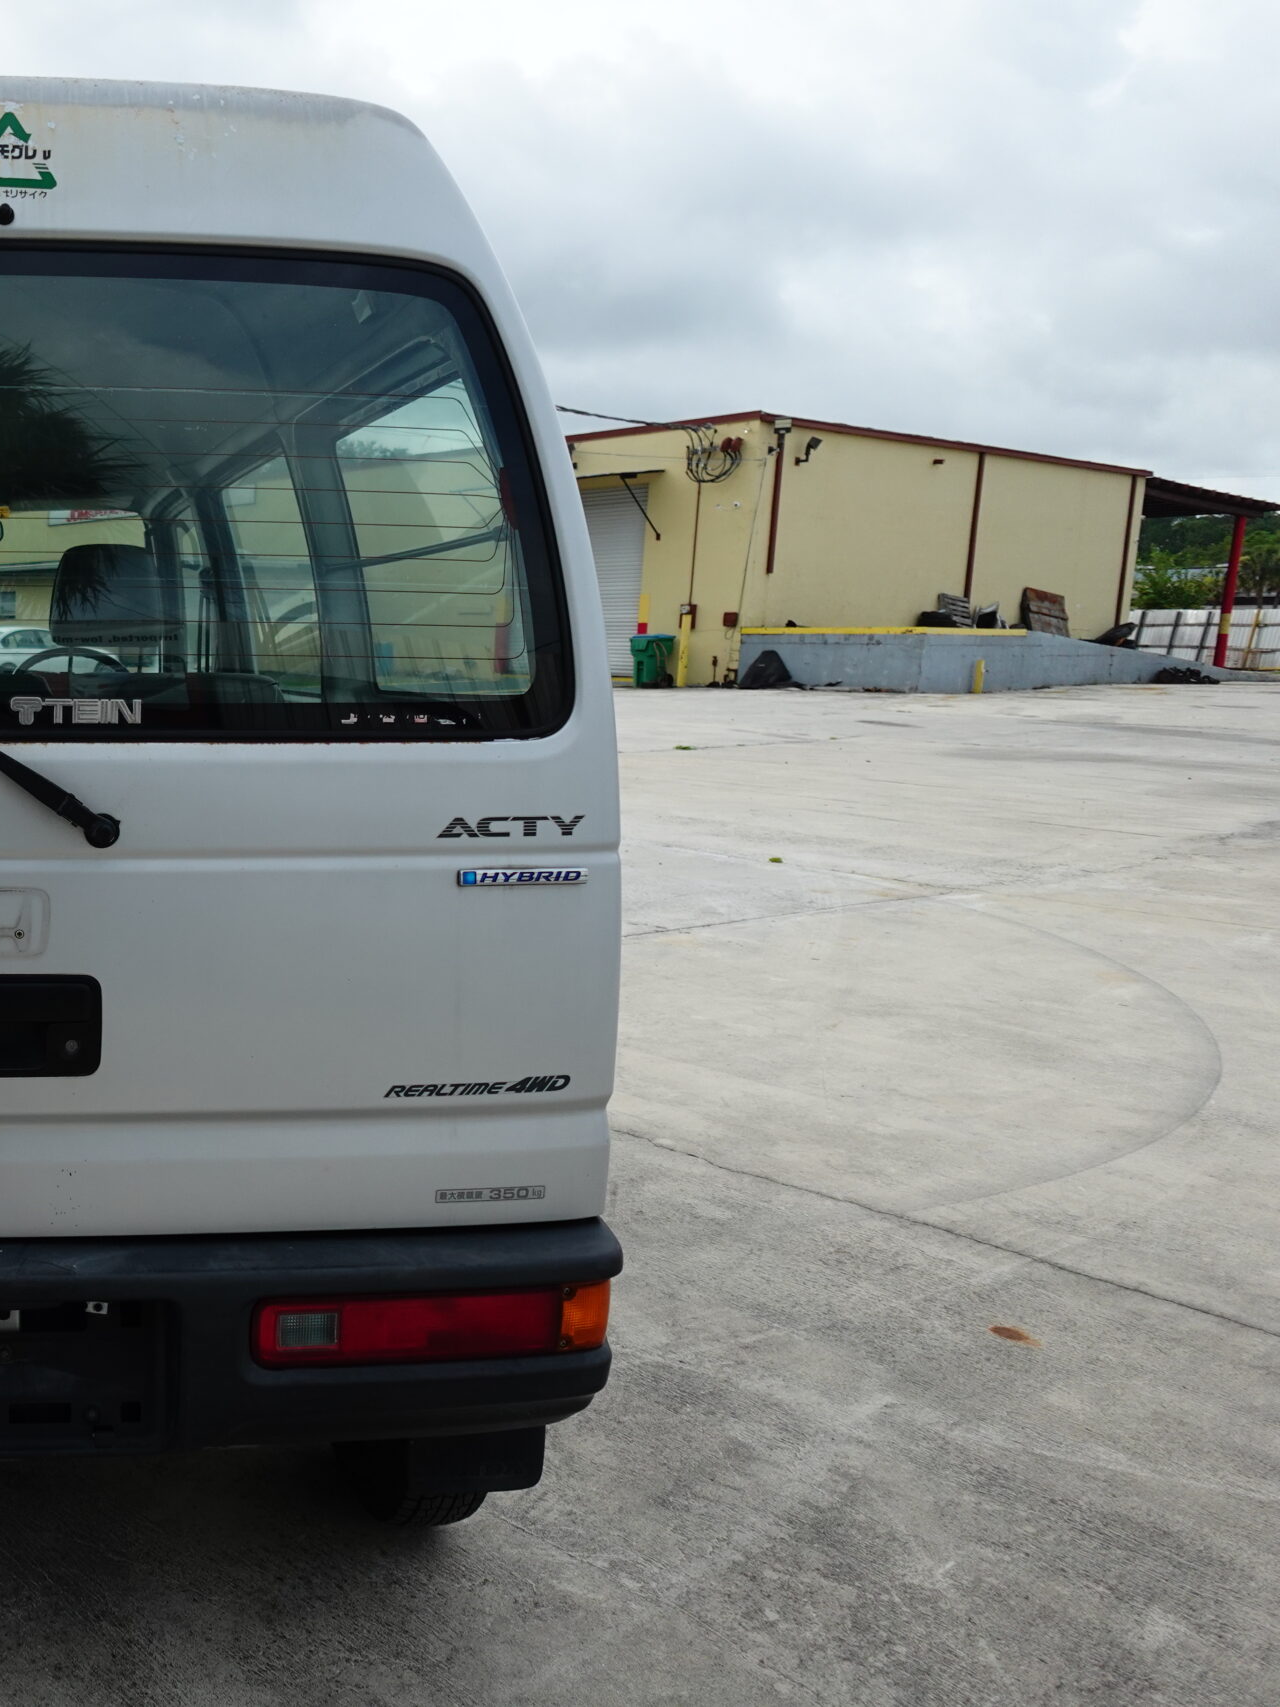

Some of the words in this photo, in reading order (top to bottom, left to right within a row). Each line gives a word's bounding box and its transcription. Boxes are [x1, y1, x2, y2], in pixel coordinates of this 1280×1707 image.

[45, 698, 142, 724] TEIN
[436, 814, 586, 838] ACTY
[479, 870, 582, 883] HYBRID
[383, 1081, 507, 1098] REALTIME
[505, 1074, 571, 1093] 4WD
[489, 1187, 529, 1200] 350
[532, 1186, 543, 1200] kg
